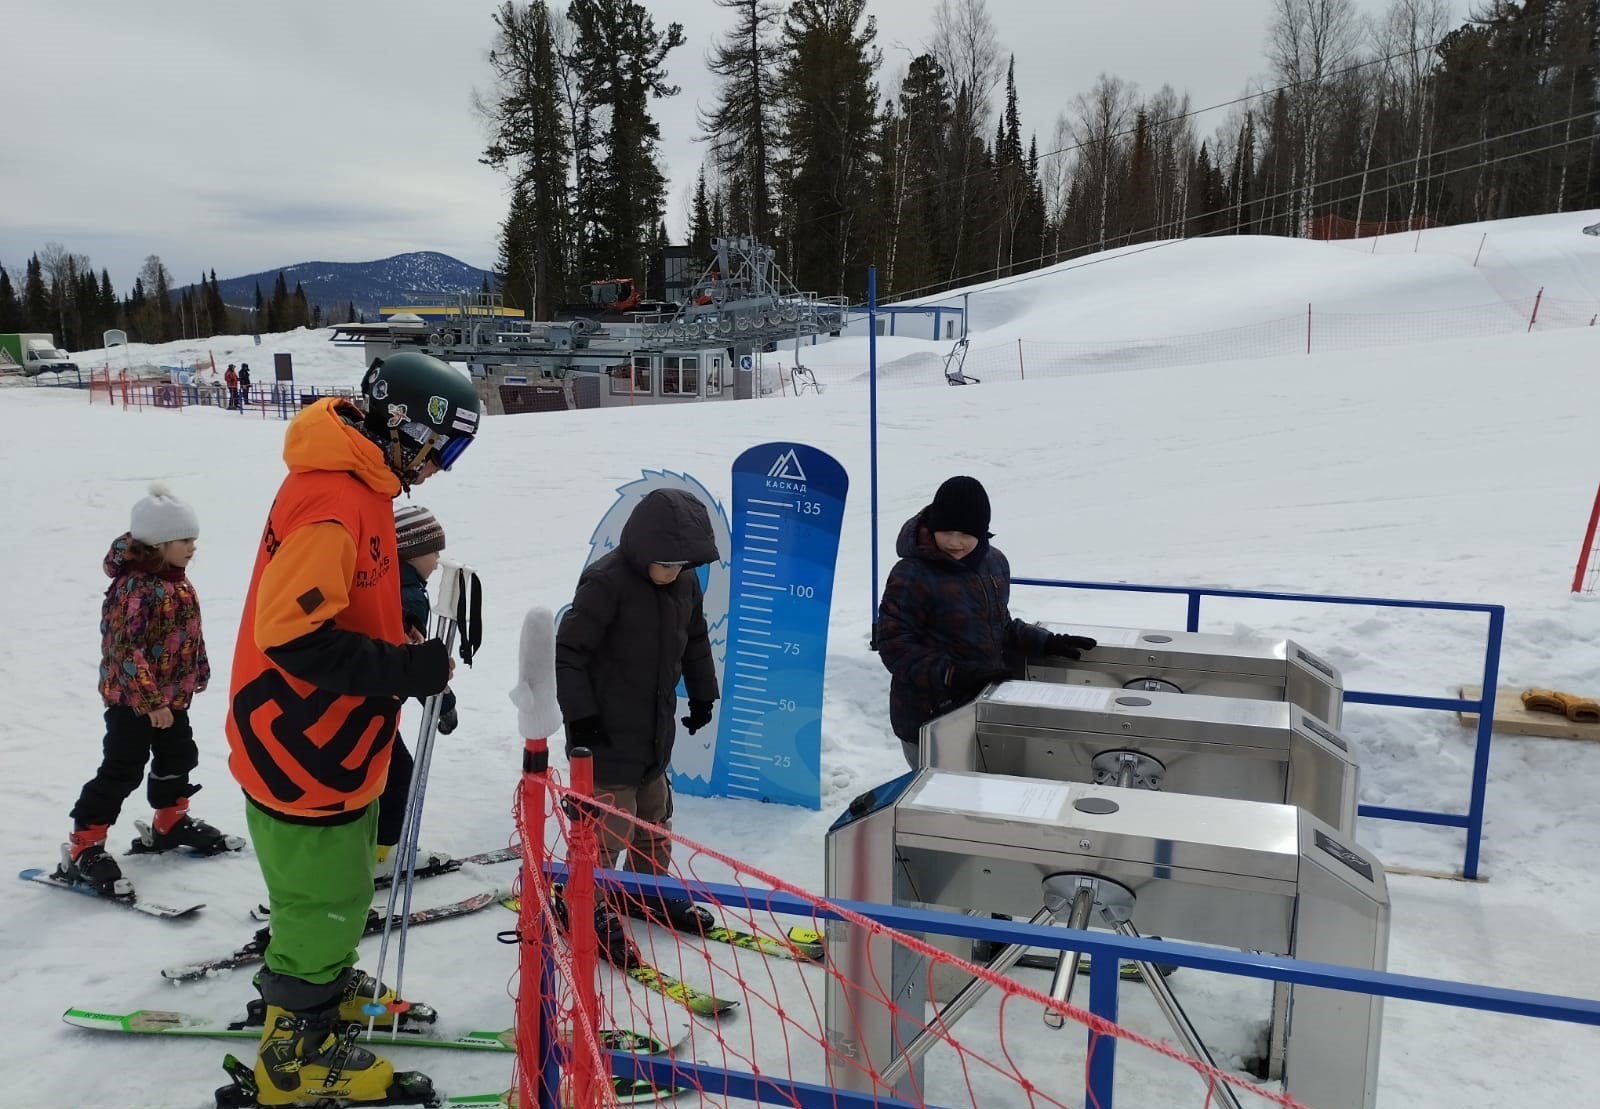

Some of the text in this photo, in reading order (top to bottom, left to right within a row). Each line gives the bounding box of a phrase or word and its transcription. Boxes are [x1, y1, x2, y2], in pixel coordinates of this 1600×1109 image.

[766, 480, 807, 494] КАСКАД
[795, 500, 821, 515] 135
[788, 584, 814, 600] 100
[783, 642, 801, 656] 75
[778, 699, 796, 713] 50
[773, 755, 791, 768] 25
